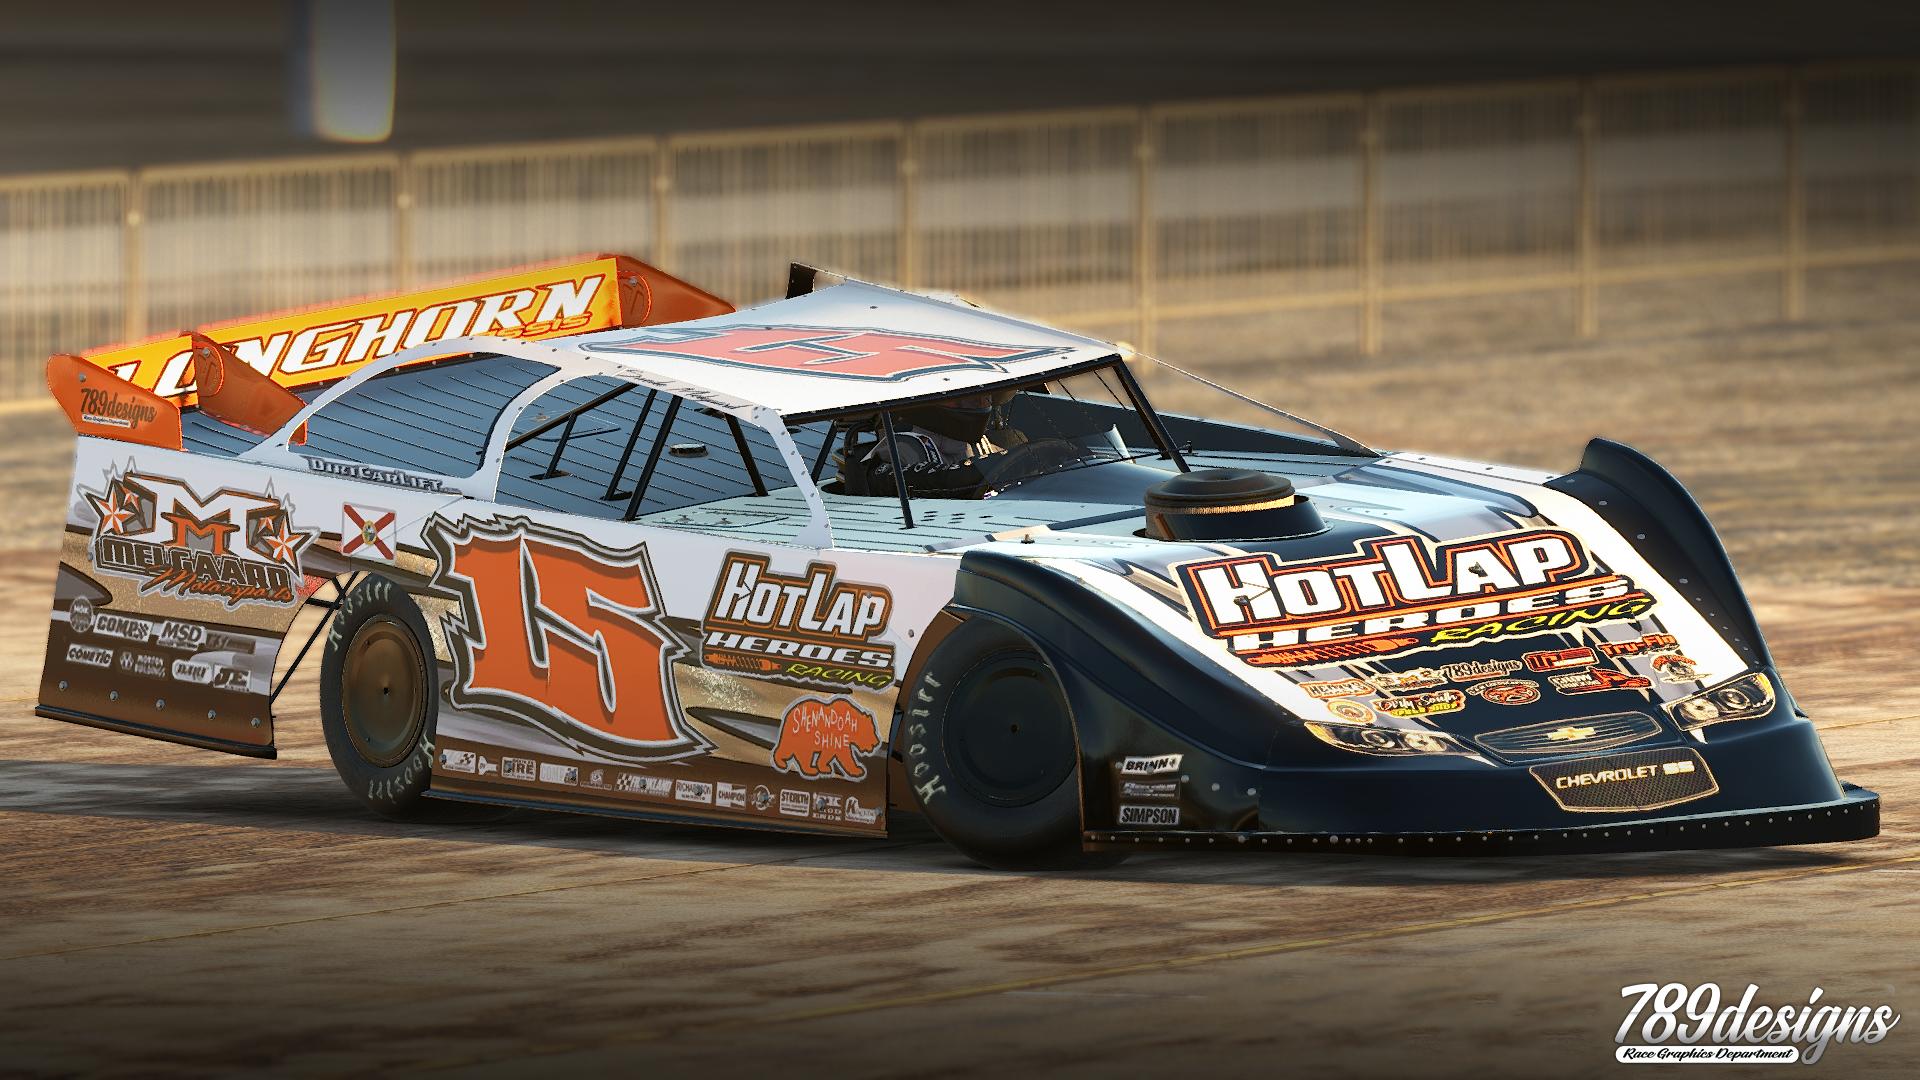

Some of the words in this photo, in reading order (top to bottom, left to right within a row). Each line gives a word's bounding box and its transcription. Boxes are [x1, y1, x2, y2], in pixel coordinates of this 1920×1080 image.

[81, 388, 157, 429] 789designs
[1232, 578, 1628, 652] HEROES
[1430, 597, 1654, 643] RACING
[161, 621, 202, 643] MSD
[440, 525, 695, 752] 15
[705, 631, 892, 669] HEROES
[786, 663, 893, 688] RACING
[1443, 659, 1522, 678] 789designs
[792, 705, 858, 734] SHENANDOAH
[814, 730, 850, 750] SHINE
[1125, 758, 1169, 771] BRINN
[1556, 765, 1658, 790] CHEVROLET
[1121, 807, 1178, 824] SIMPSON
